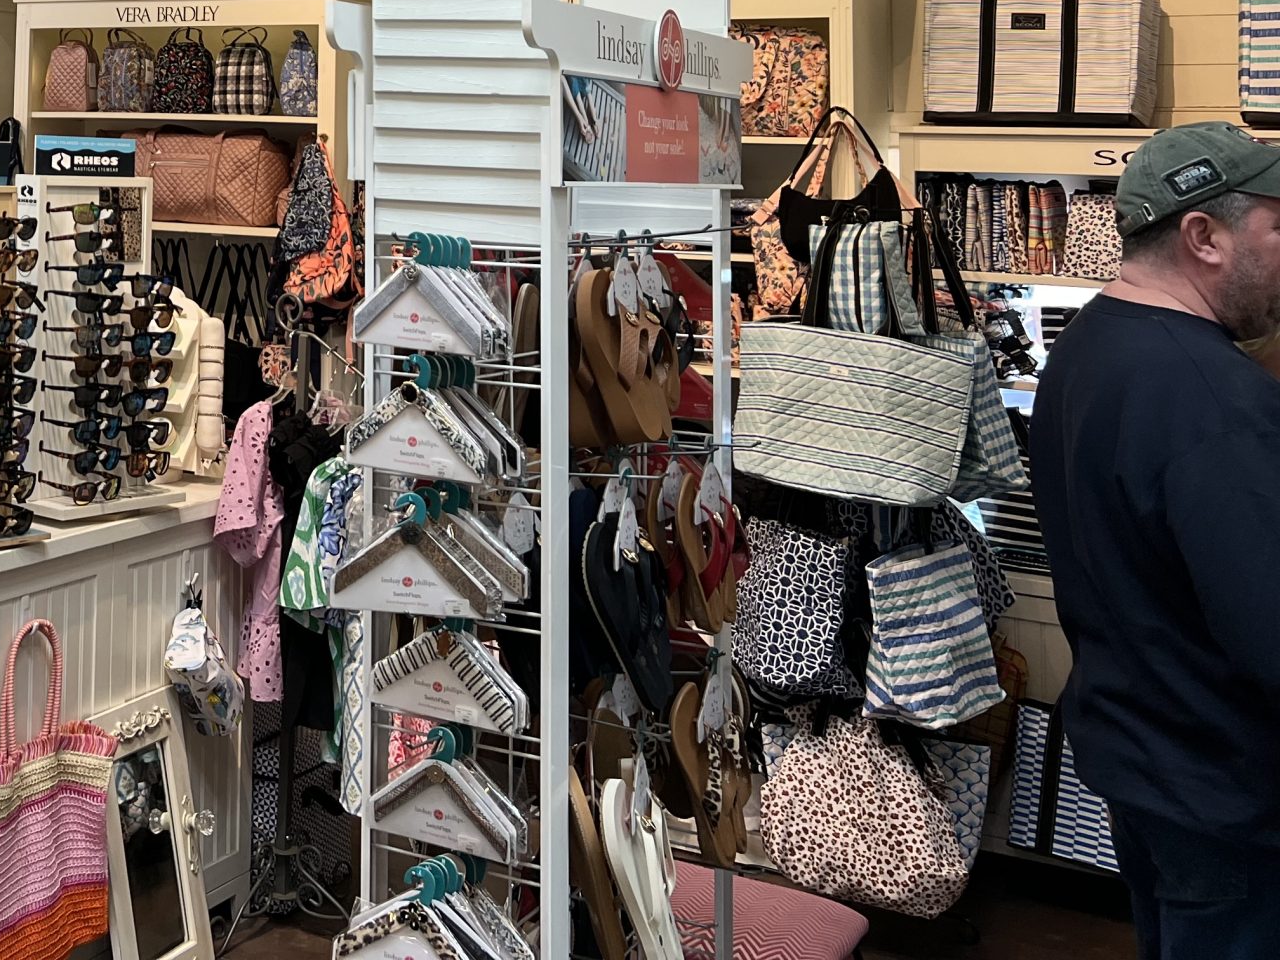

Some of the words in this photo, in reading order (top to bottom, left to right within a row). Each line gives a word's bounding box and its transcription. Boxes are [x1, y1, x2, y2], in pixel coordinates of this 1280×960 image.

[115, 6, 152, 24] VERA
[157, 5, 220, 24] BRADLEY
[596, 20, 647, 79] lindsay
[681, 38, 720, 90] hillips
[638, 110, 661, 135] Change
[661, 118, 675, 135] your
[676, 113, 689, 131] look
[73, 155, 119, 166] RHEOS
[655, 143, 669, 160] your
